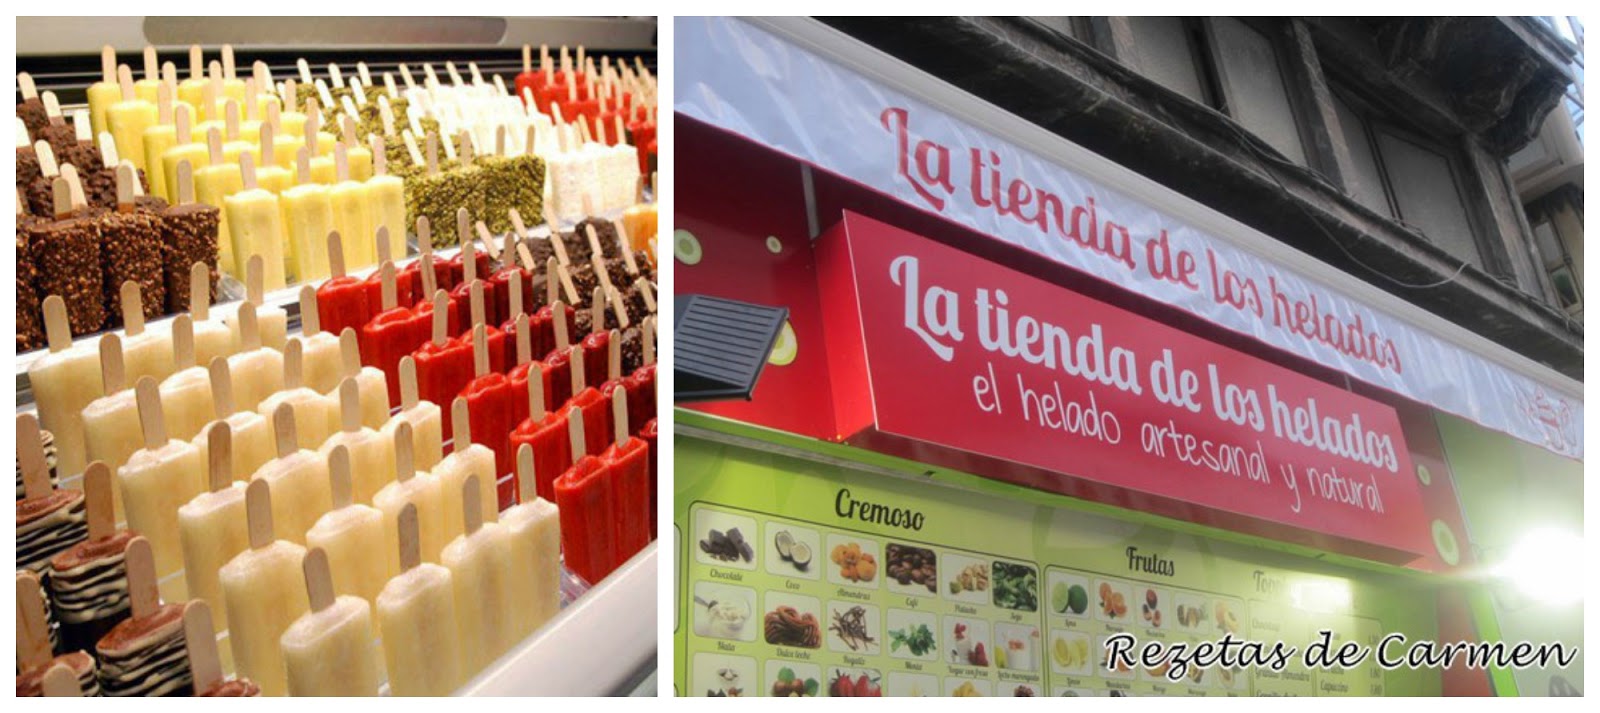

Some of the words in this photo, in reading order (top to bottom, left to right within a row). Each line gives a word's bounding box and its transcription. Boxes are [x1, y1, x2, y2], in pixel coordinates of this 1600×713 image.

[880, 107, 955, 212] La
[970, 147, 1136, 270] tienda
[1146, 229, 1199, 291] de
[1207, 248, 1264, 319] los
[1268, 276, 1402, 375] helados
[889, 255, 964, 362] La
[974, 288, 1142, 396] tienda
[1150, 349, 1201, 412] de
[1208, 363, 1265, 432] los
[1267, 384, 1398, 472] helados
[973, 362, 1002, 414] el
[1017, 373, 1121, 444] helado
[1141, 419, 1270, 484] artesanal
[1280, 463, 1301, 513] y
[1306, 467, 1384, 514] natural
[835, 488, 925, 531] Cremoso
[709, 568, 743, 582] Chocolate
[1125, 546, 1175, 577] Frutas
